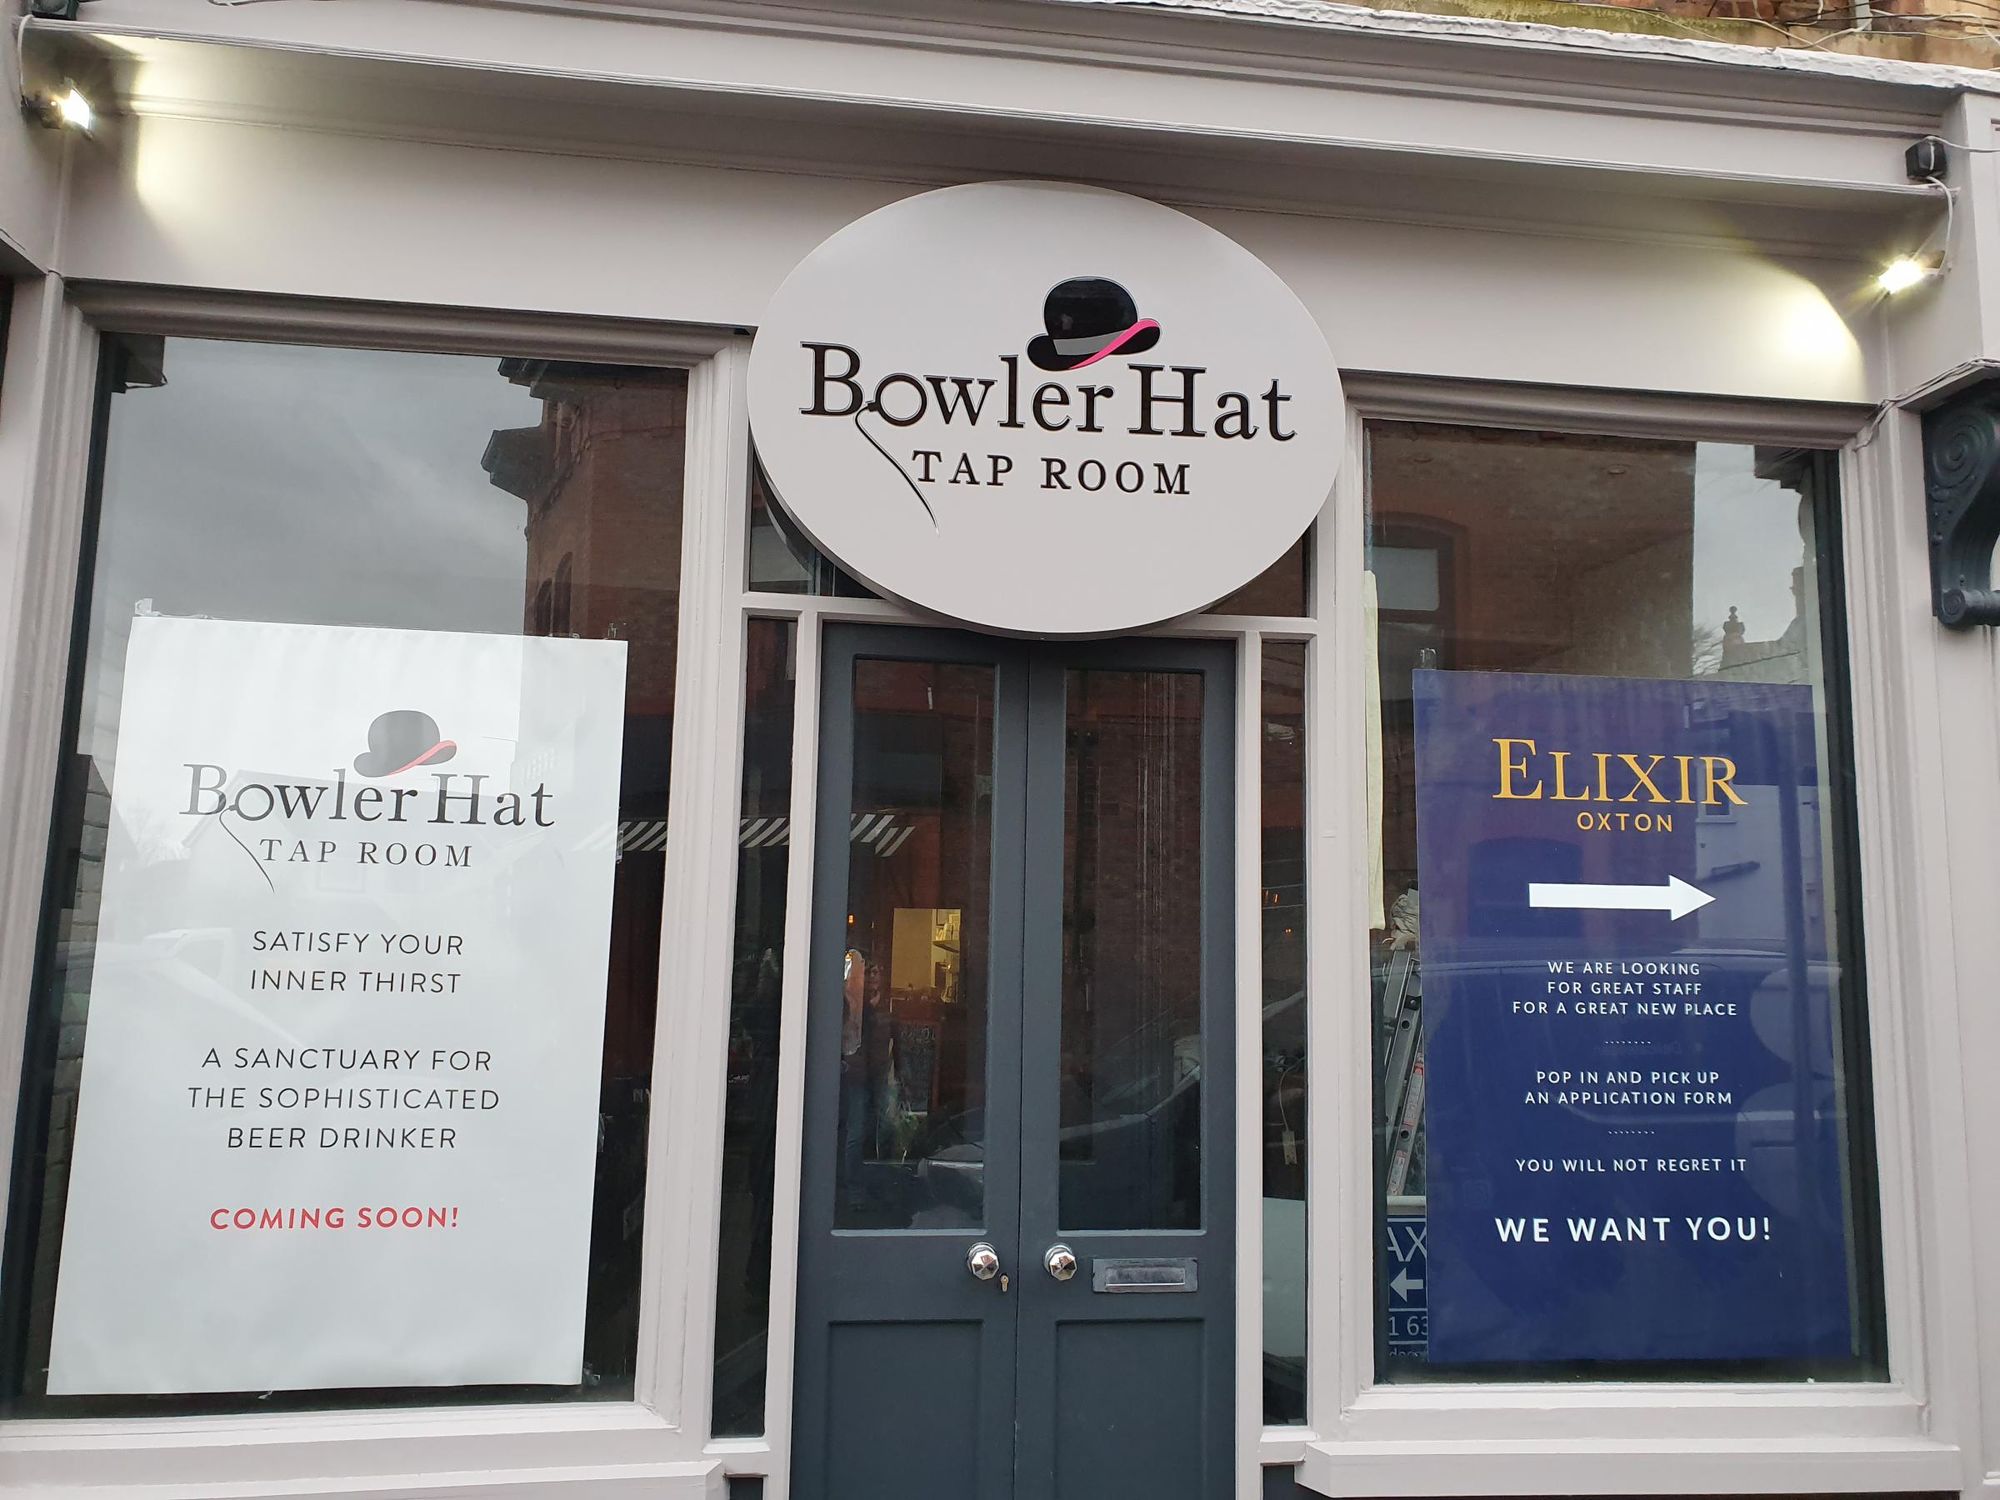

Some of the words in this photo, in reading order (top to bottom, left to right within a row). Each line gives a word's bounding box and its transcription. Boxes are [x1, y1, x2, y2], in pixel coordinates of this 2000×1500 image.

[799, 341, 1114, 432] Bowler
[1127, 363, 1296, 442] Hat
[912, 450, 1013, 487] TAP
[1040, 457, 1191, 495] ROOM
[1492, 738, 1749, 805] ELIXIR
[179, 762, 418, 824] Bowler
[426, 773, 555, 828] Hat
[1576, 811, 1674, 833] OXTON
[259, 839, 337, 864] TAP
[357, 841, 472, 867] ROOM
[252, 930, 370, 953] SATISFY
[380, 933, 463, 956] YOUR
[1547, 961, 1574, 974] WE
[1582, 961, 1613, 974] ARE
[1621, 962, 1700, 976] LOOKING
[251, 969, 347, 992] INNER
[359, 971, 461, 994] THIRST
[1547, 981, 1582, 994] FOR
[1590, 982, 1645, 995] GREAT
[1652, 982, 1702, 995] STAFF
[1512, 1001, 1548, 1014] FOR
[1556, 1001, 1567, 1014] A
[1575, 1001, 1629, 1015] GREAT
[1637, 1002, 1677, 1015] NEW
[1684, 1003, 1737, 1016] PLACE
[201, 1047, 222, 1068] A
[234, 1047, 420, 1070] SANCTUARY
[432, 1050, 491, 1071] FOR
[1536, 1071, 1572, 1084] POP
[1580, 1071, 1598, 1084] IN
[1606, 1071, 1642, 1084] AND
[1651, 1071, 1691, 1084] PICK
[1697, 1071, 1719, 1084] UP
[188, 1087, 246, 1108] THE
[258, 1087, 499, 1110] SOPHISTICATED
[1524, 1091, 1549, 1104] AN
[1558, 1091, 1676, 1105] APPLICATION
[1684, 1091, 1732, 1105] FORM
[227, 1127, 306, 1149] BEER
[319, 1127, 456, 1149] DRINKER
[1515, 1159, 1553, 1172] YOU
[1562, 1159, 1606, 1172] WILL
[1613, 1158, 1649, 1172] NOT
[1657, 1158, 1722, 1172] REGRET
[1730, 1158, 1747, 1172] IT
[210, 1206, 346, 1231] COMING
[357, 1206, 459, 1230] SOON!
[1494, 1218, 1550, 1243] WE
[1566, 1217, 1671, 1242] WANT
[1685, 1216, 1770, 1241] YOU!
